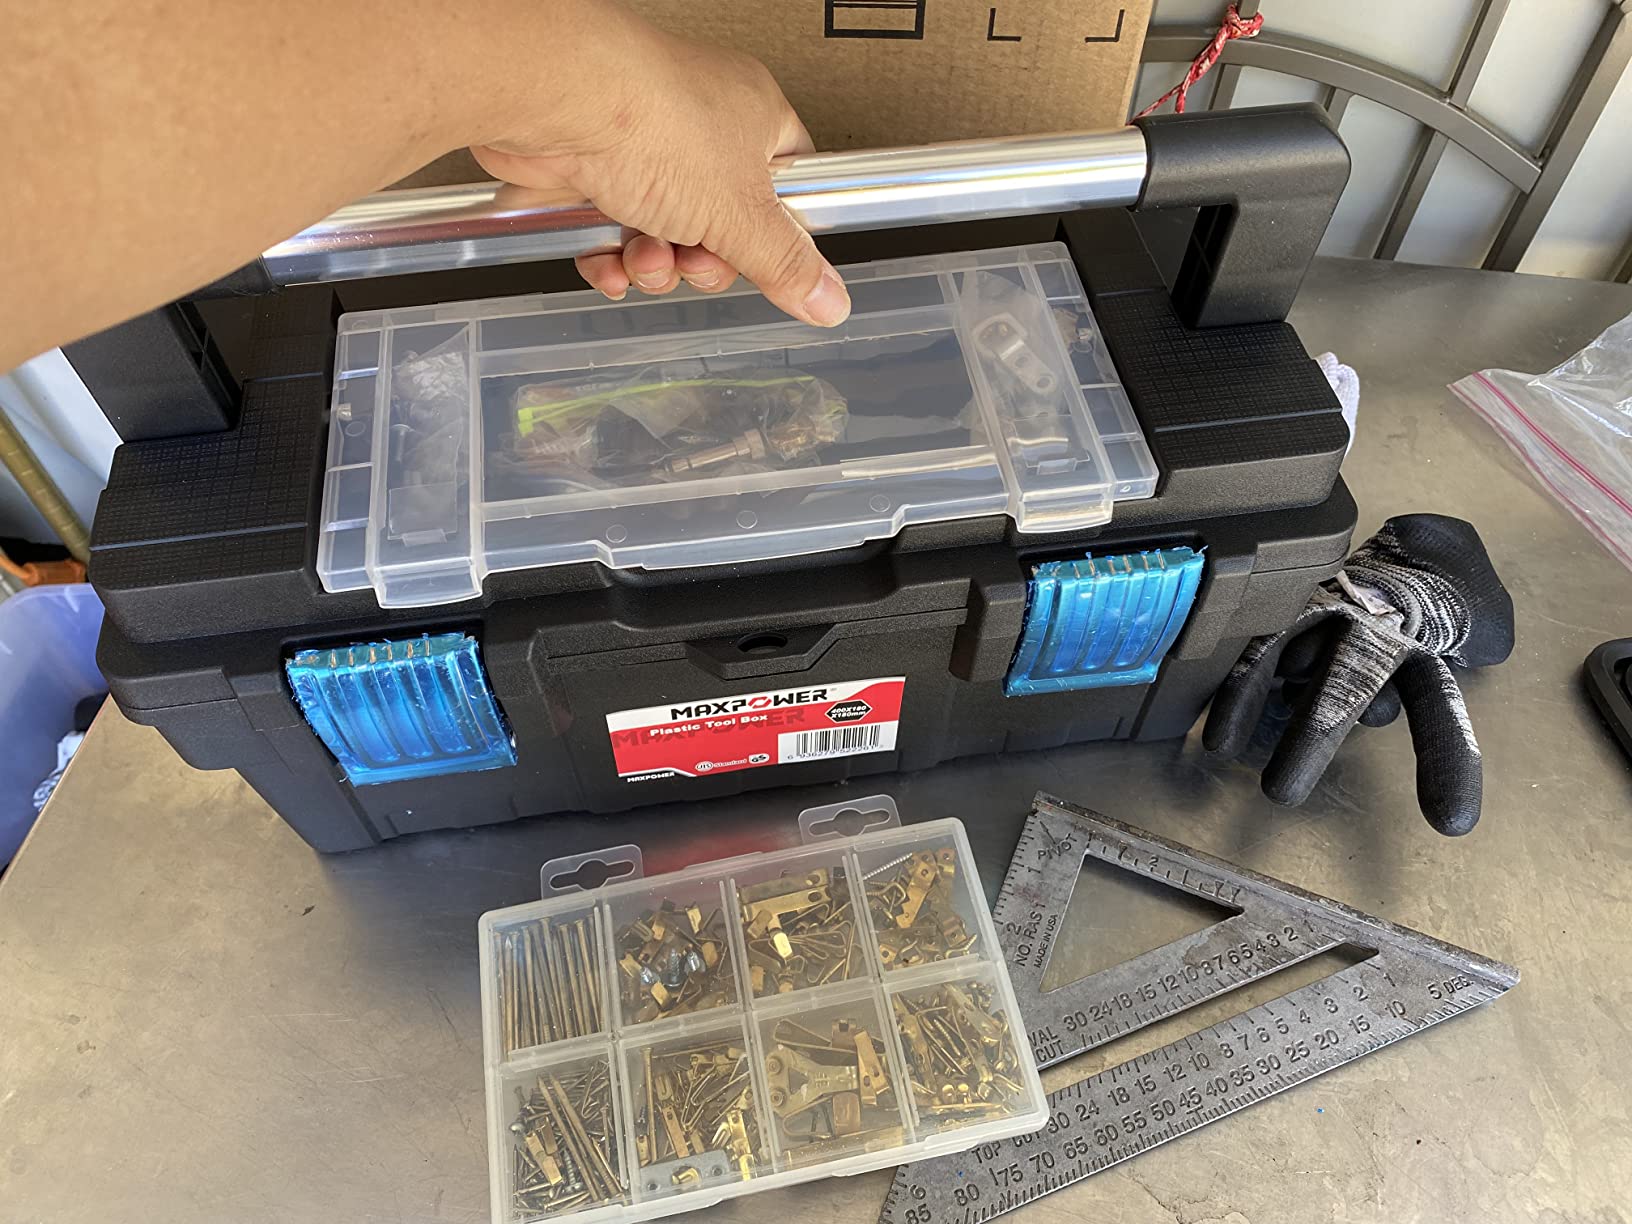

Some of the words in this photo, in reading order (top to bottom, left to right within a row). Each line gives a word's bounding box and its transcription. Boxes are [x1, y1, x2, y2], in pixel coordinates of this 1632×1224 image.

[671, 688, 828, 720] MAXPOWER
[649, 722, 701, 737] Plastic
[704, 717, 737, 729] Tool
[740, 712, 769, 724] Box
[626, 771, 676, 783] MAXPOWER
[1037, 832, 1078, 860] PIVOT
[1046, 914, 1059, 933] USA
[1043, 930, 1053, 943] IN
[1013, 942, 1033, 967] NO.
[1033, 941, 1047, 968] MADE
[1063, 1011, 1088, 1032] 30
[1089, 1000, 1113, 1022] 24
[1112, 992, 1134, 1011] 18
[1135, 983, 1157, 1002] 15
[1157, 974, 1180, 993] 12
[1178, 964, 1199, 984] 10
[1200, 959, 1215, 976] 8
[1212, 954, 1224, 971] 7
[1227, 949, 1241, 965] 6
[1240, 943, 1254, 959] 5
[1255, 938, 1267, 953] 4
[1266, 933, 1281, 948] 3
[1283, 926, 1299, 942] 2
[1035, 1039, 1066, 1063] CUT
[1047, 1111, 1070, 1134] 30
[1075, 1099, 1100, 1122] 24
[1107, 1086, 1131, 1106] 18
[1134, 1074, 1157, 1095] 15
[1163, 1063, 1187, 1082] 12
[1187, 1052, 1210, 1072] 10
[1237, 1033, 1249, 1050] 7
[1256, 1026, 1271, 1043] 6
[1275, 1017, 1290, 1035] 5
[1299, 1009, 1311, 1024] 4
[1323, 997, 1339, 1014] 3
[1353, 986, 1369, 1002] 2
[1383, 972, 1396, 988] 1
[904, 1203, 932, 1224] 85
[953, 1183, 980, 1207] 80
[996, 1163, 1024, 1187] 75
[1029, 1151, 1055, 1174] 70
[1062, 1136, 1089, 1160] 65
[1093, 1123, 1119, 1146] 60
[1121, 1110, 1147, 1134] 55
[1150, 1099, 1176, 1122] 50
[1178, 1086, 1202, 1108] 45
[1205, 1076, 1229, 1098] 40
[1229, 1064, 1255, 1087] 35
[1255, 1053, 1281, 1075] 30
[1285, 1040, 1310, 1063] 25
[1314, 1028, 1340, 1051] 20
[1349, 1014, 1371, 1035] 15
[1384, 1001, 1407, 1018] 10
[1427, 982, 1443, 1000] 5
[1443, 974, 1475, 994] DEG.
[970, 1140, 1002, 1164] TOP
